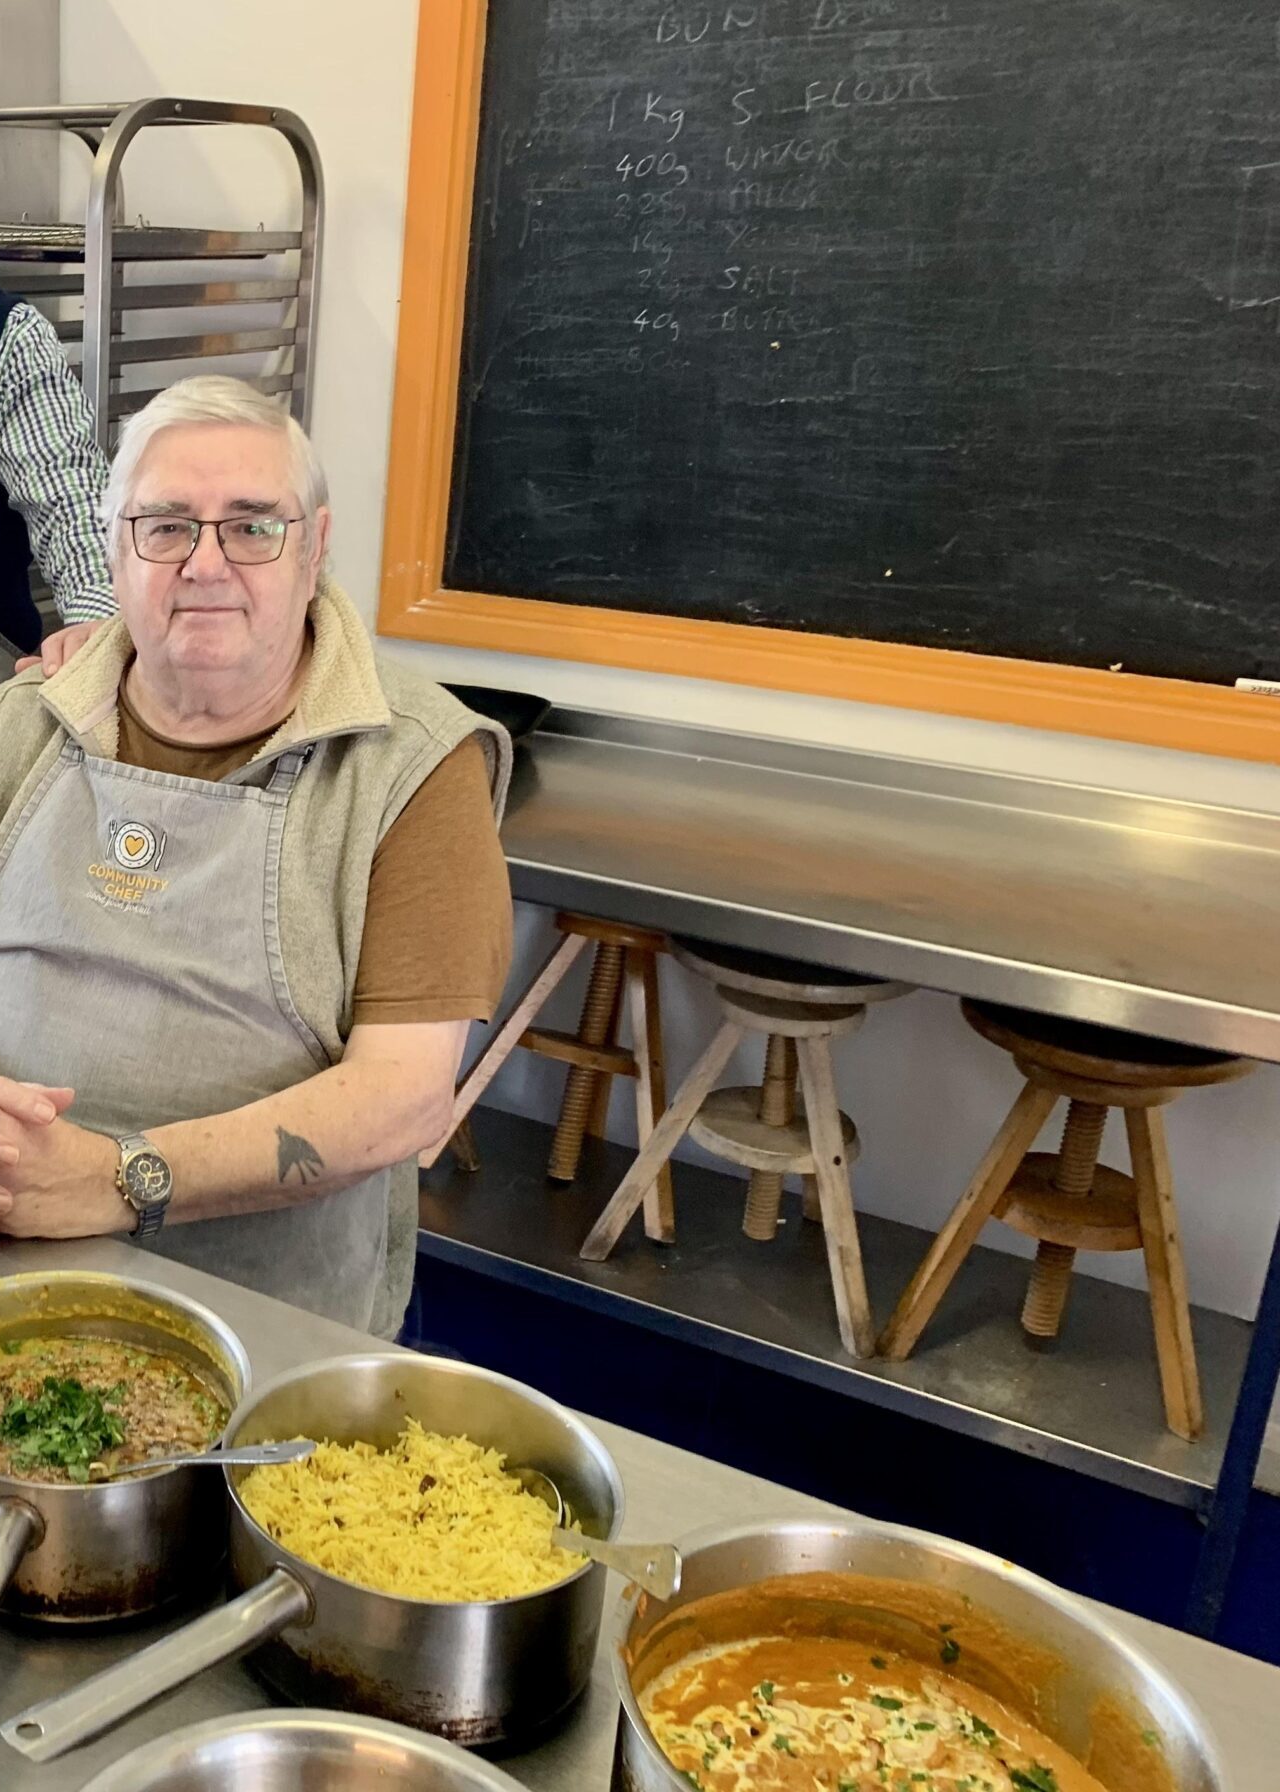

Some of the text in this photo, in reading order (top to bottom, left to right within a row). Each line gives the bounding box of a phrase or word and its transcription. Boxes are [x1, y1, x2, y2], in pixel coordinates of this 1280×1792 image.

[655, 5, 757, 44] BUN
[804, 71, 944, 113] FLOUR
[615, 151, 689, 186] 400g
[632, 308, 680, 342] 40g
[87, 863, 169, 891] COMMUNITY
[104, 883, 144, 901] CHEF
